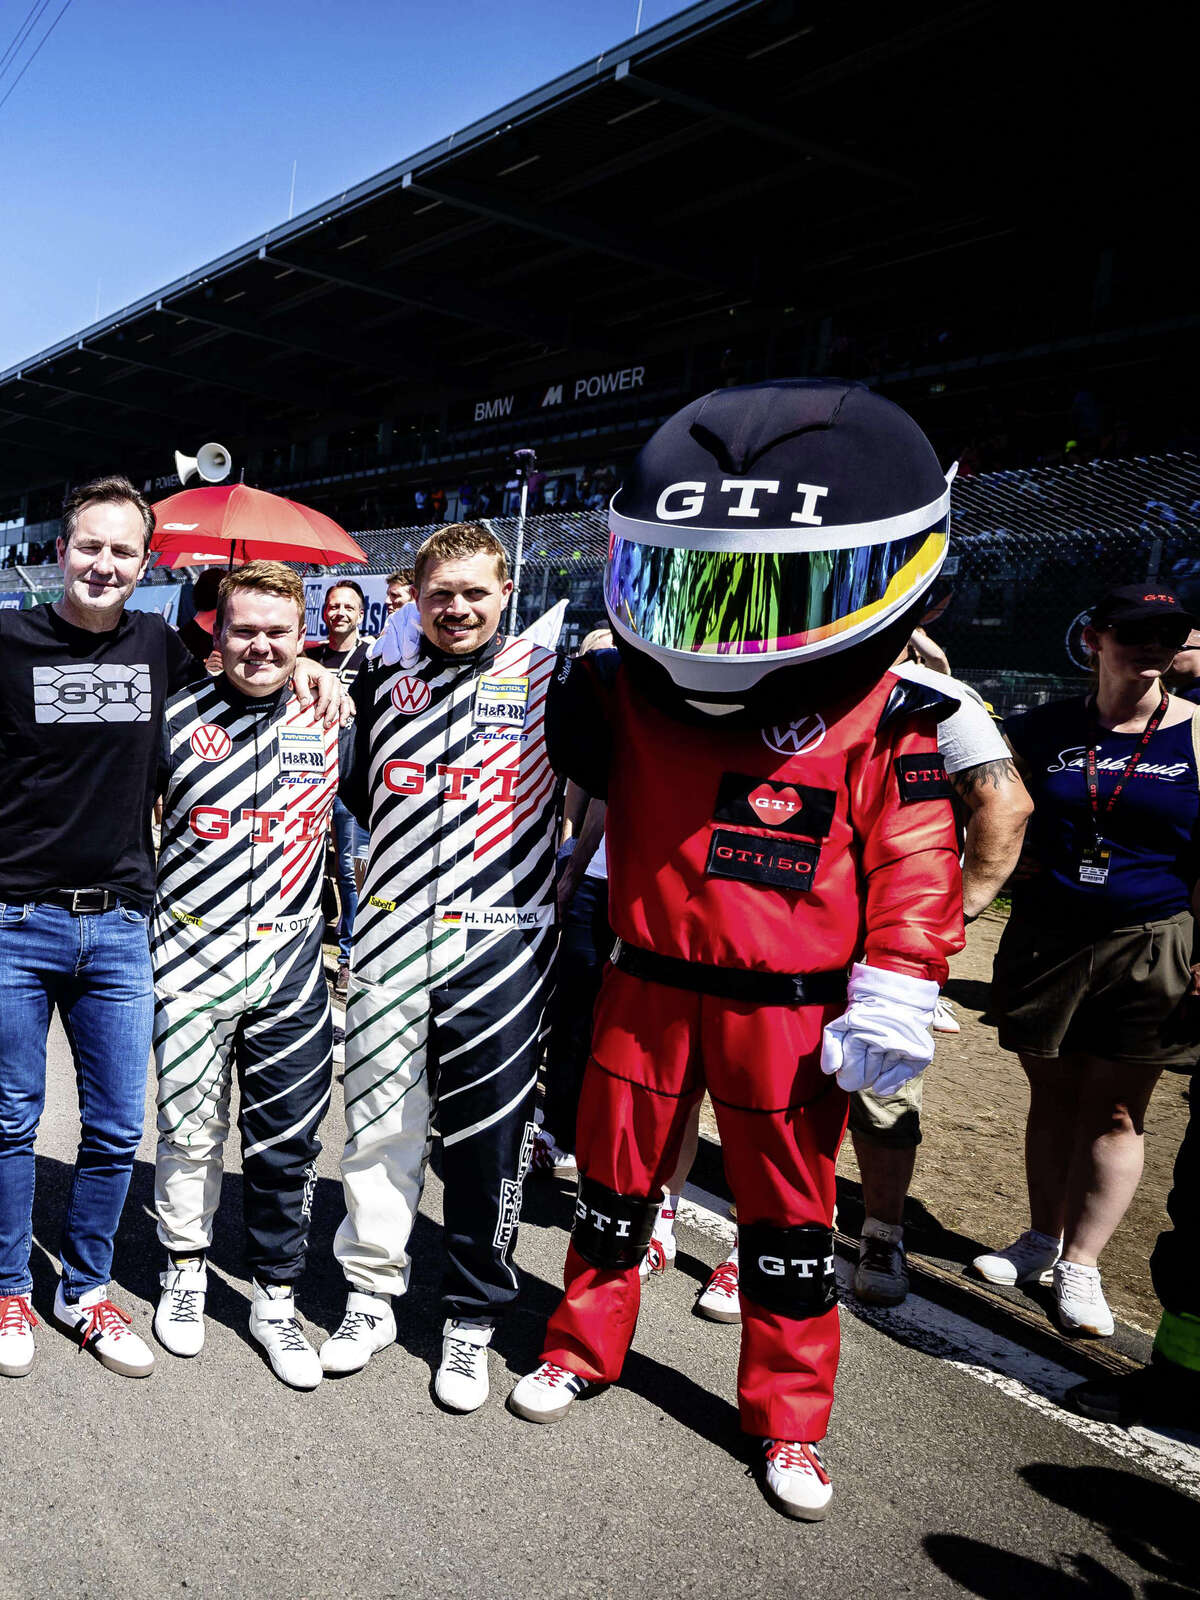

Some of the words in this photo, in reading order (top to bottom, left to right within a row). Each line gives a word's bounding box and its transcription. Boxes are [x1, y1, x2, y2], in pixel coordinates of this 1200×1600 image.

[474, 395, 514, 421] BMW
[575, 366, 645, 400] POWER
[656, 479, 829, 526] GTI
[57, 682, 137, 705] GTI
[475, 732, 529, 741] FALKEN
[280, 777, 327, 785] FALKEN
[383, 759, 520, 803] GTI
[755, 798, 796, 812] GTI
[188, 805, 317, 844] GTI
[370, 897, 394, 910] Sabelt
[275, 922, 287, 934] N.
[465, 912, 479, 923] H.
[484, 912, 539, 924] HAMMEL
[576, 1199, 632, 1238] GTI
[757, 1254, 836, 1279] GTI
